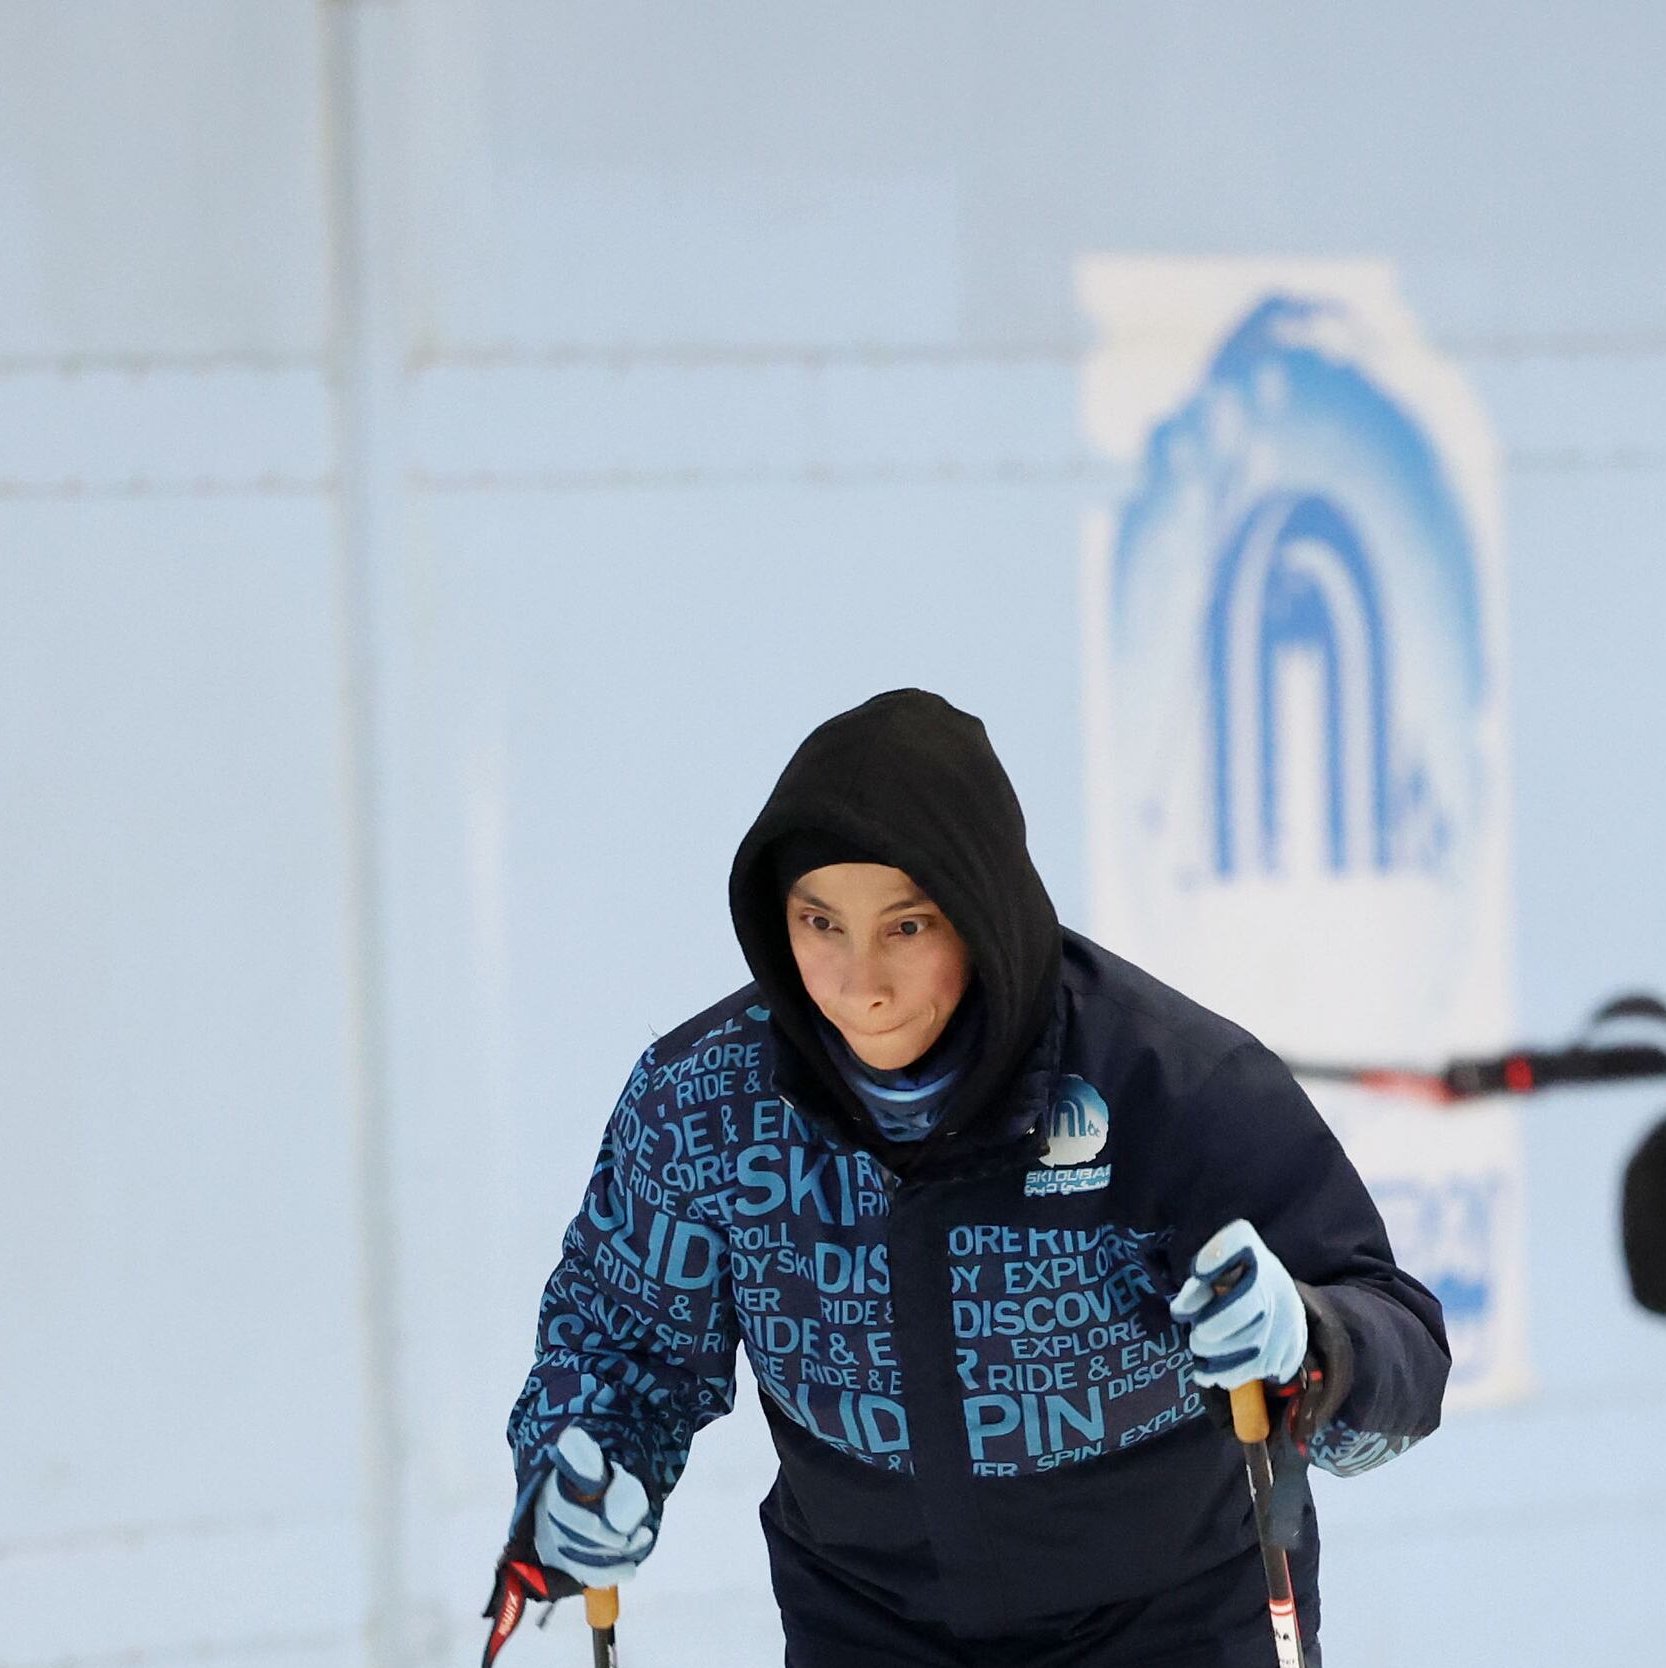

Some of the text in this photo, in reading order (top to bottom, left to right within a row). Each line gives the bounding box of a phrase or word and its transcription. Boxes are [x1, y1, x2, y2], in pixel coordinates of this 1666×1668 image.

[653, 1042, 761, 1091] EXPLORE
[676, 1071, 735, 1109] RIDE
[743, 1072, 761, 1094] &
[720, 1104, 739, 1145] &
[629, 1164, 680, 1217] RIDE
[735, 1144, 855, 1227] SKI
[1026, 1163, 1112, 1184] SKI DUBAI
[594, 1241, 661, 1309] RIDE
[668, 1294, 693, 1322] &
[952, 1262, 1158, 1339] DISCOVER
[820, 1296, 879, 1326] RIDE
[828, 1331, 861, 1366] &
[1010, 1311, 1148, 1360] EXPLORE
[800, 1357, 862, 1390] RIDE
[867, 1369, 884, 1392] &
[987, 1361, 1079, 1392] RIDE
[1087, 1354, 1113, 1381] &
